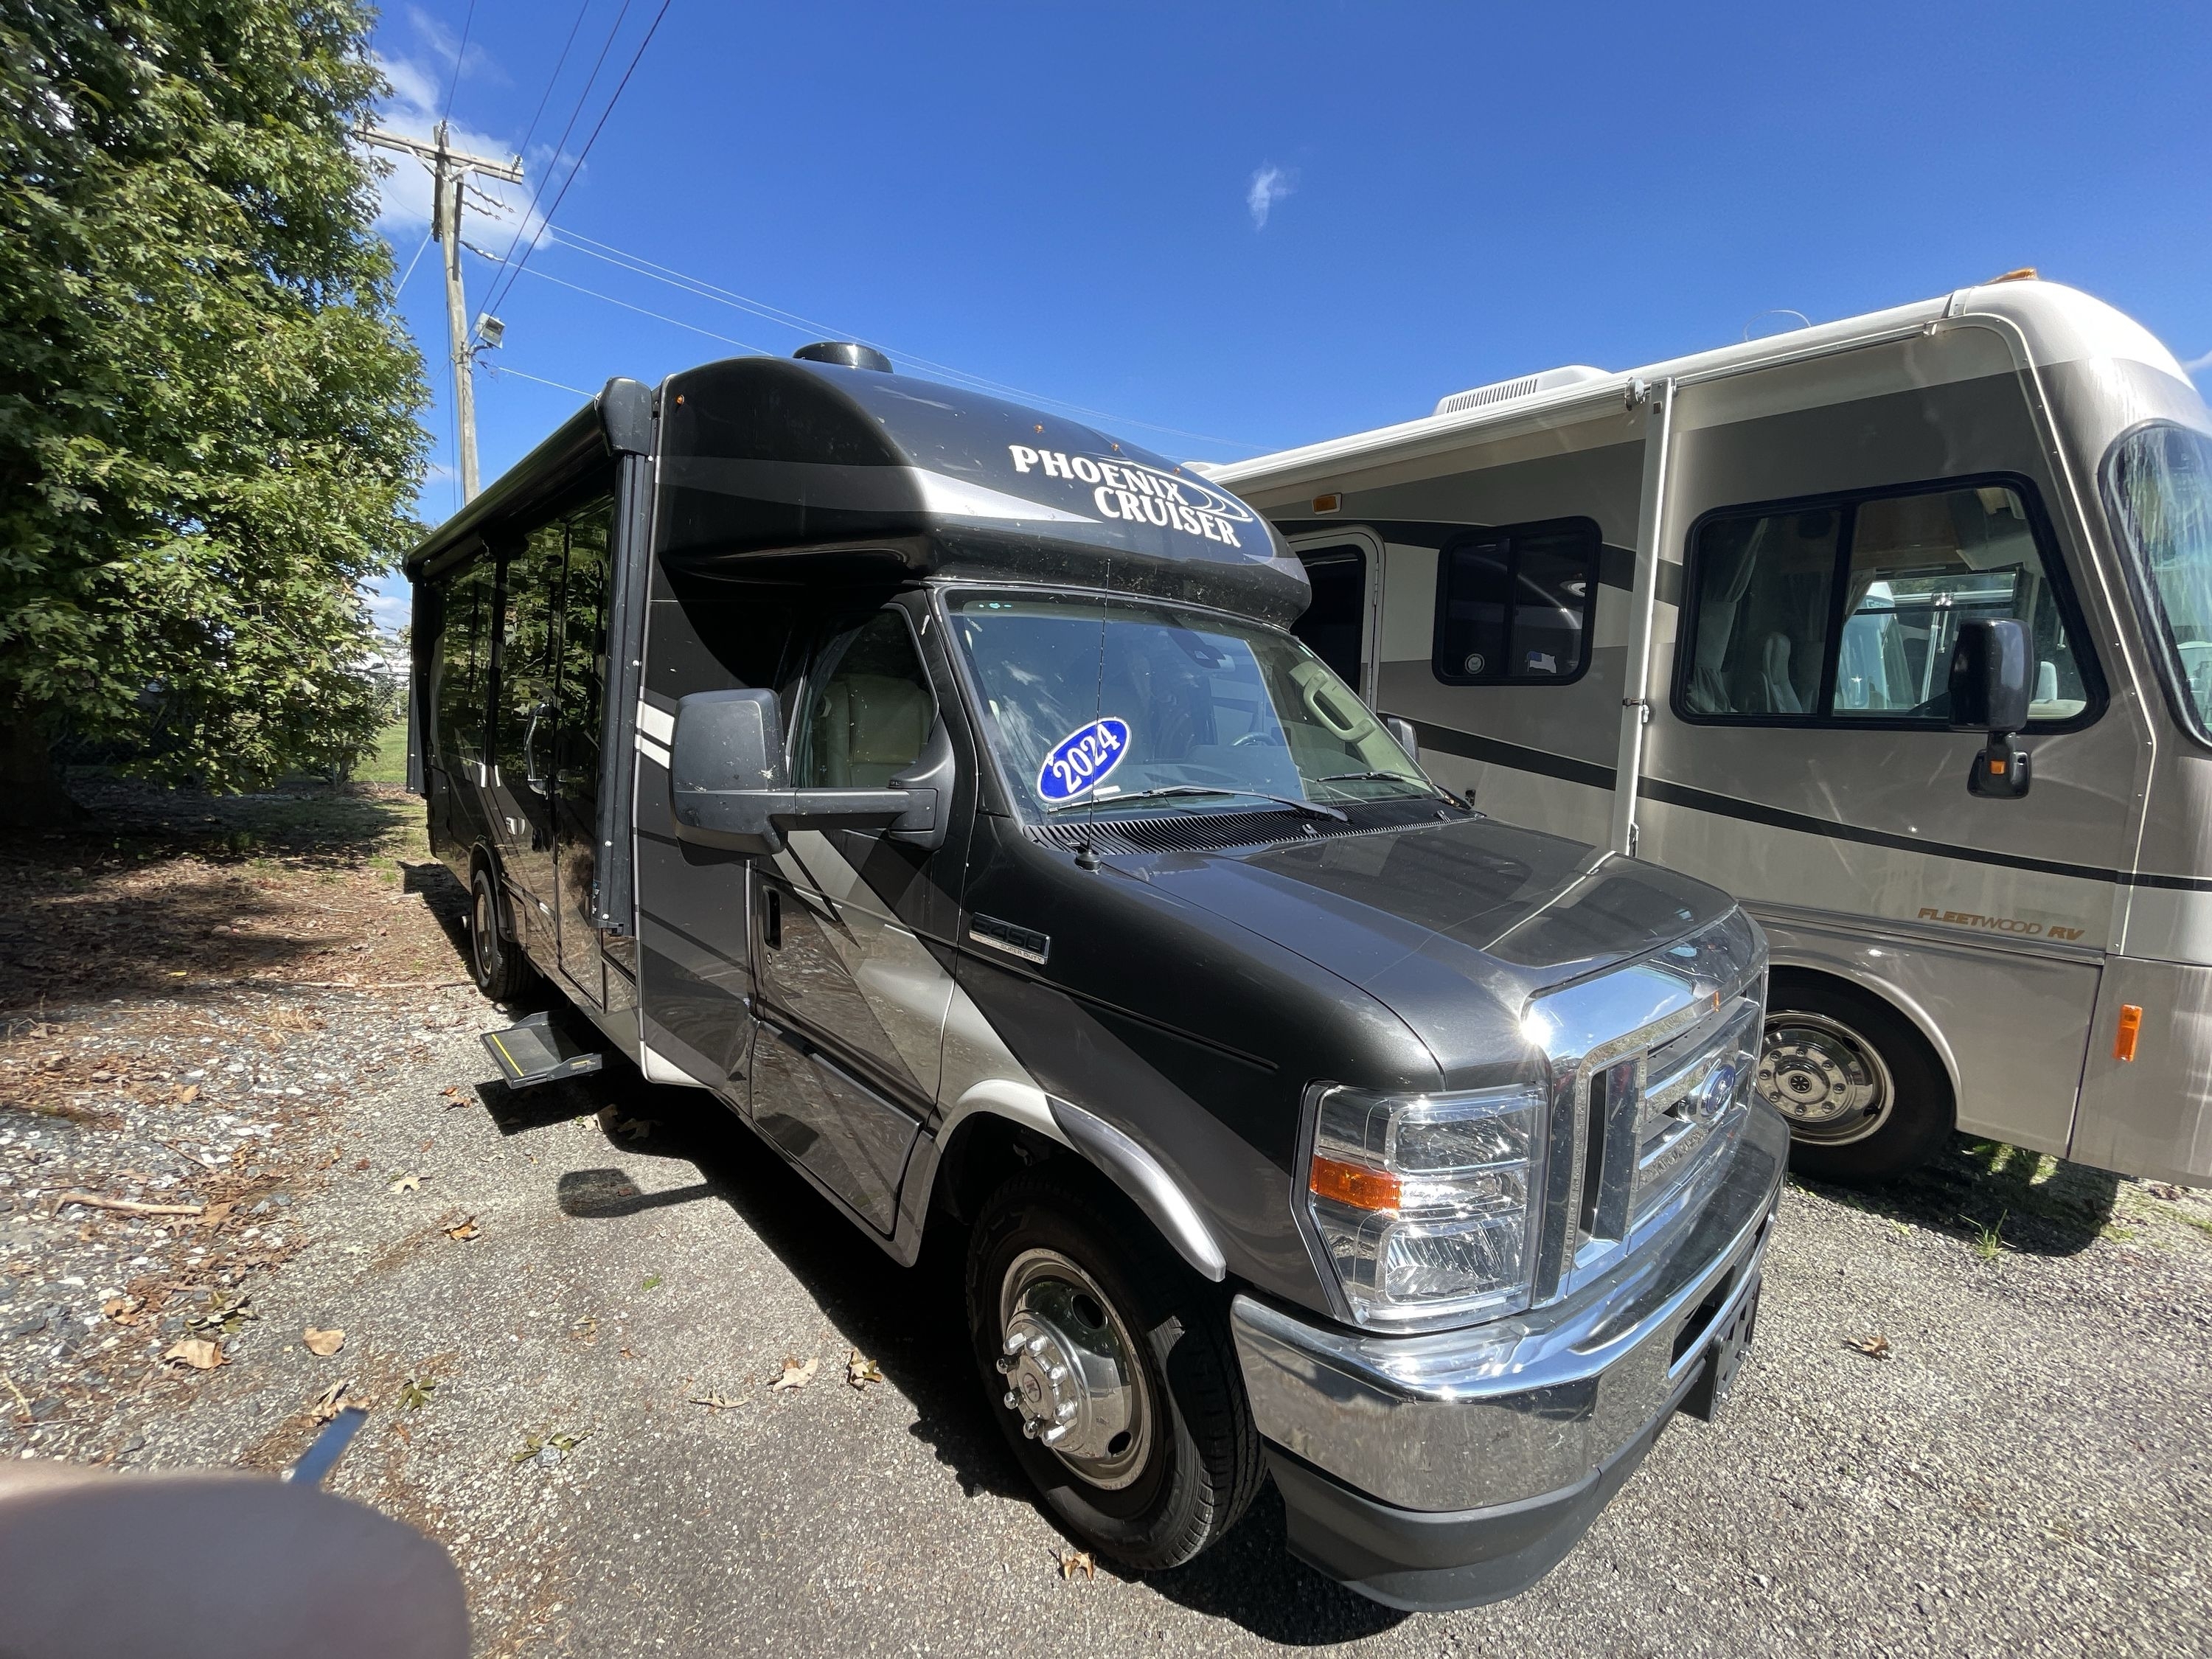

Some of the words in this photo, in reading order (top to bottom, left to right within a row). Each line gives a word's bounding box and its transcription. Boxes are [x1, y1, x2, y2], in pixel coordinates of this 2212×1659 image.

[1009, 445, 1189, 507] PHOENIX
[1094, 486, 1242, 548] CRUISER
[1053, 723, 1121, 793] 2024
[1001, 945, 1023, 956] SUPER
[1023, 952, 1042, 961] DUTY
[1918, 908, 2043, 934] FLEETWOOD
[2047, 926, 2086, 940] RV
